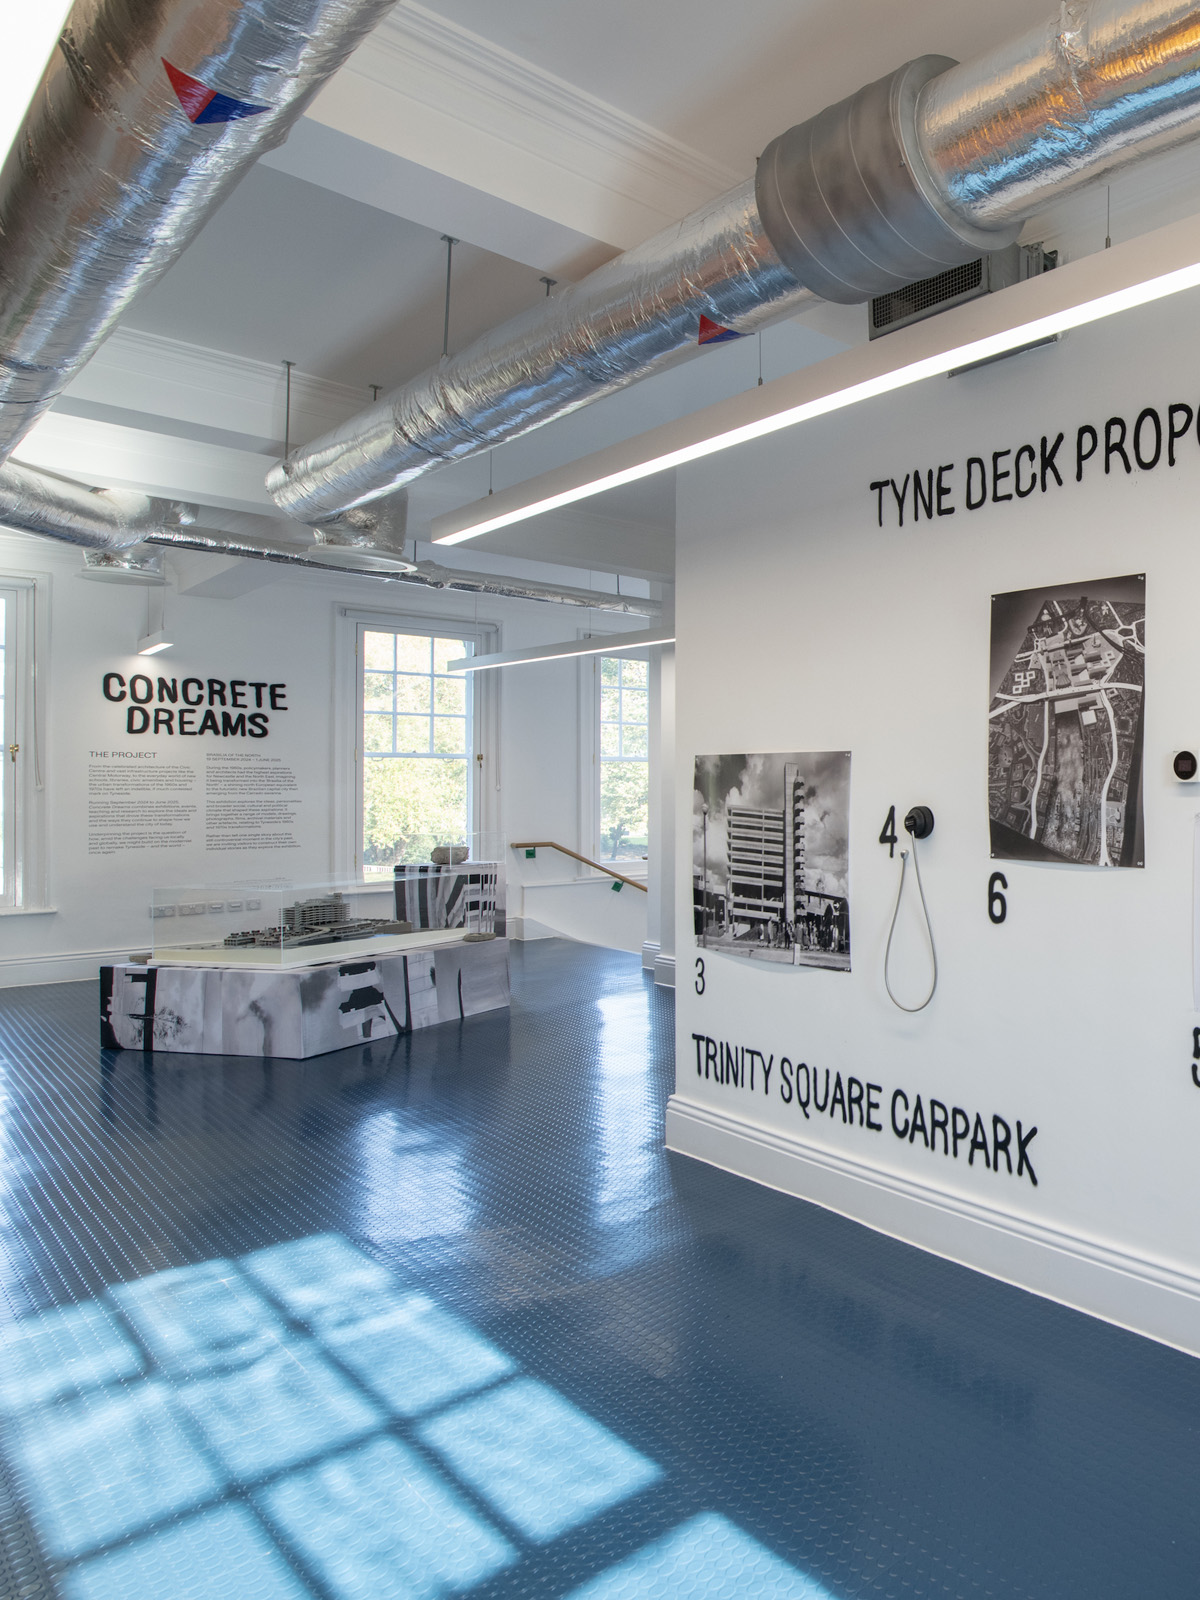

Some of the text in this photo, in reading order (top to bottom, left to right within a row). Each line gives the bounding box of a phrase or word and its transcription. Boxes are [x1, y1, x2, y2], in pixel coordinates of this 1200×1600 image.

[870, 463, 955, 528] TYNE
[966, 432, 1064, 510] DECK
[102, 672, 288, 711] CONCRETE
[126, 706, 269, 738] DREAMS
[879, 804, 898, 858] 4
[988, 871, 1008, 924] 6
[695, 957, 706, 996] 3
[692, 1033, 1038, 1186] TRINITY SQUARE CARPARK
